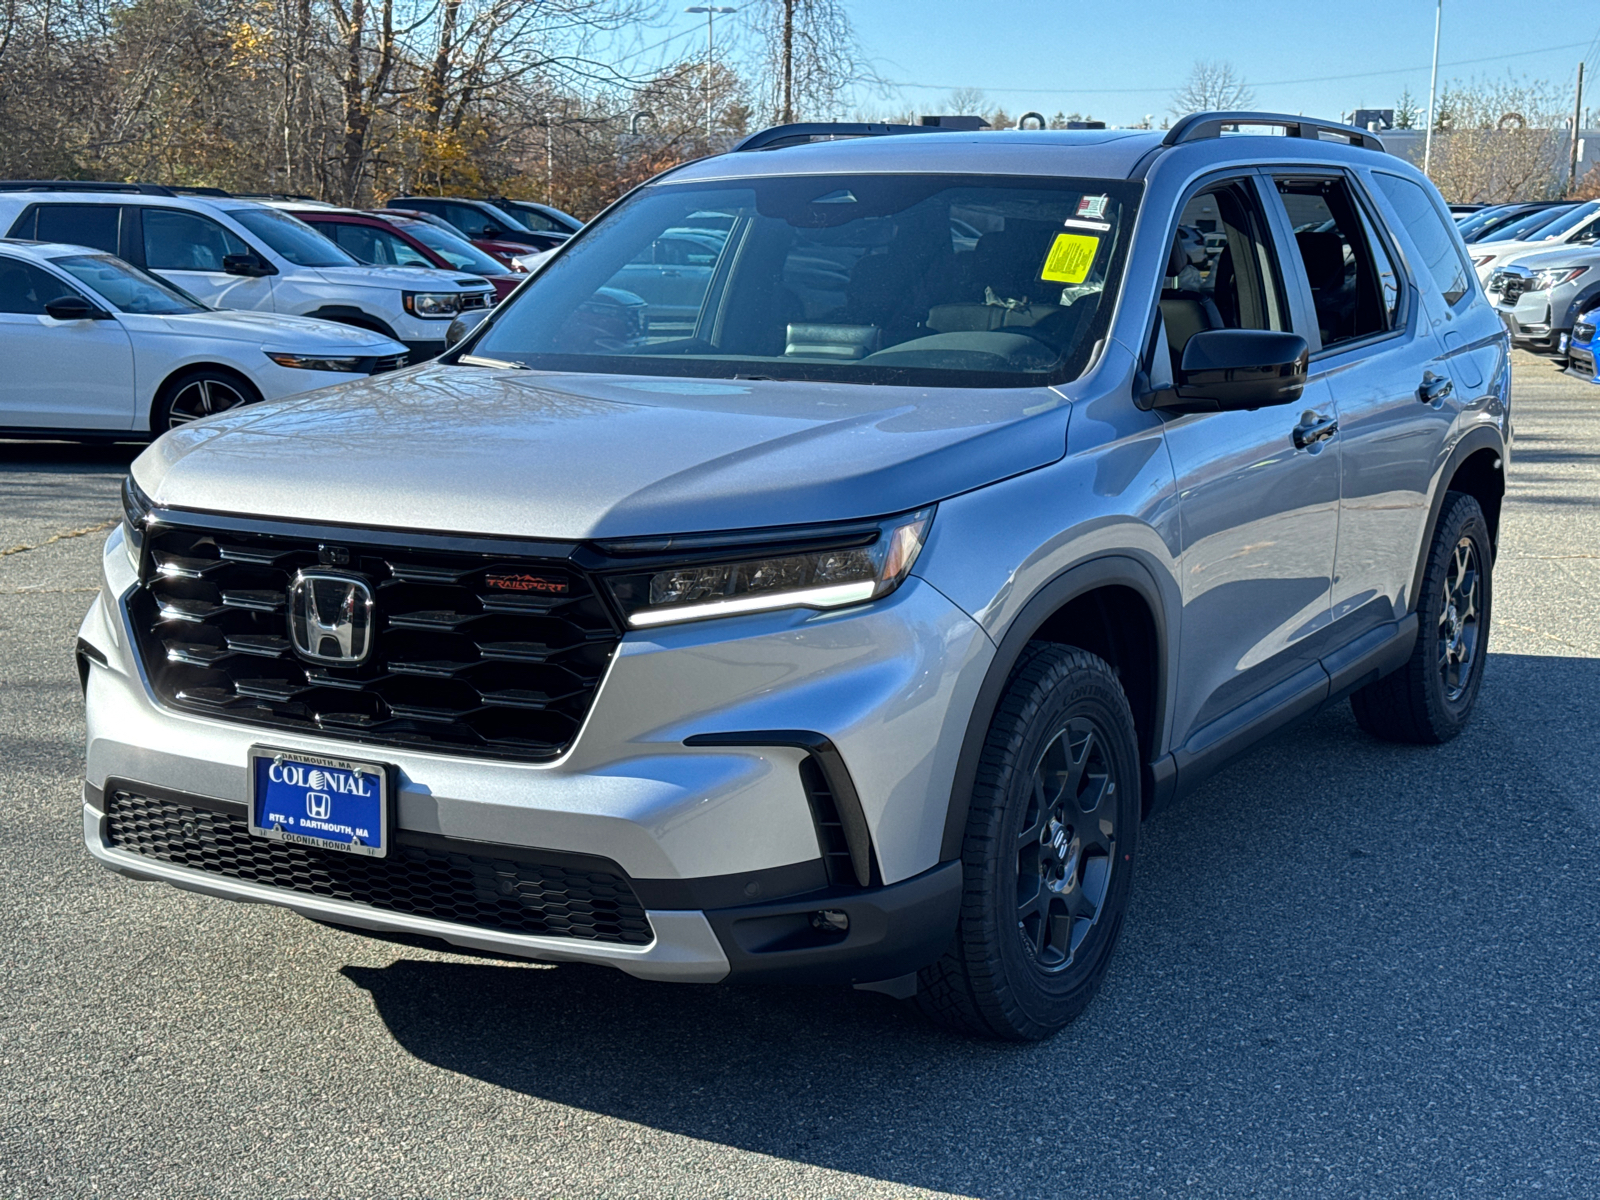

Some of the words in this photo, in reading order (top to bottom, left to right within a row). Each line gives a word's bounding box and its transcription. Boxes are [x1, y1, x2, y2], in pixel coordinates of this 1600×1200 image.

[487, 579, 566, 592] TRAILSPORT
[338, 761, 352, 769] MA
[269, 762, 371, 797] COLONIAL
[269, 812, 287, 824] RTE.
[288, 816, 295, 825] 6
[300, 818, 354, 836] DARTMOUTH,
[355, 827, 369, 838] MA
[281, 832, 320, 847] COLONIAL
[322, 840, 352, 852] HONDA
